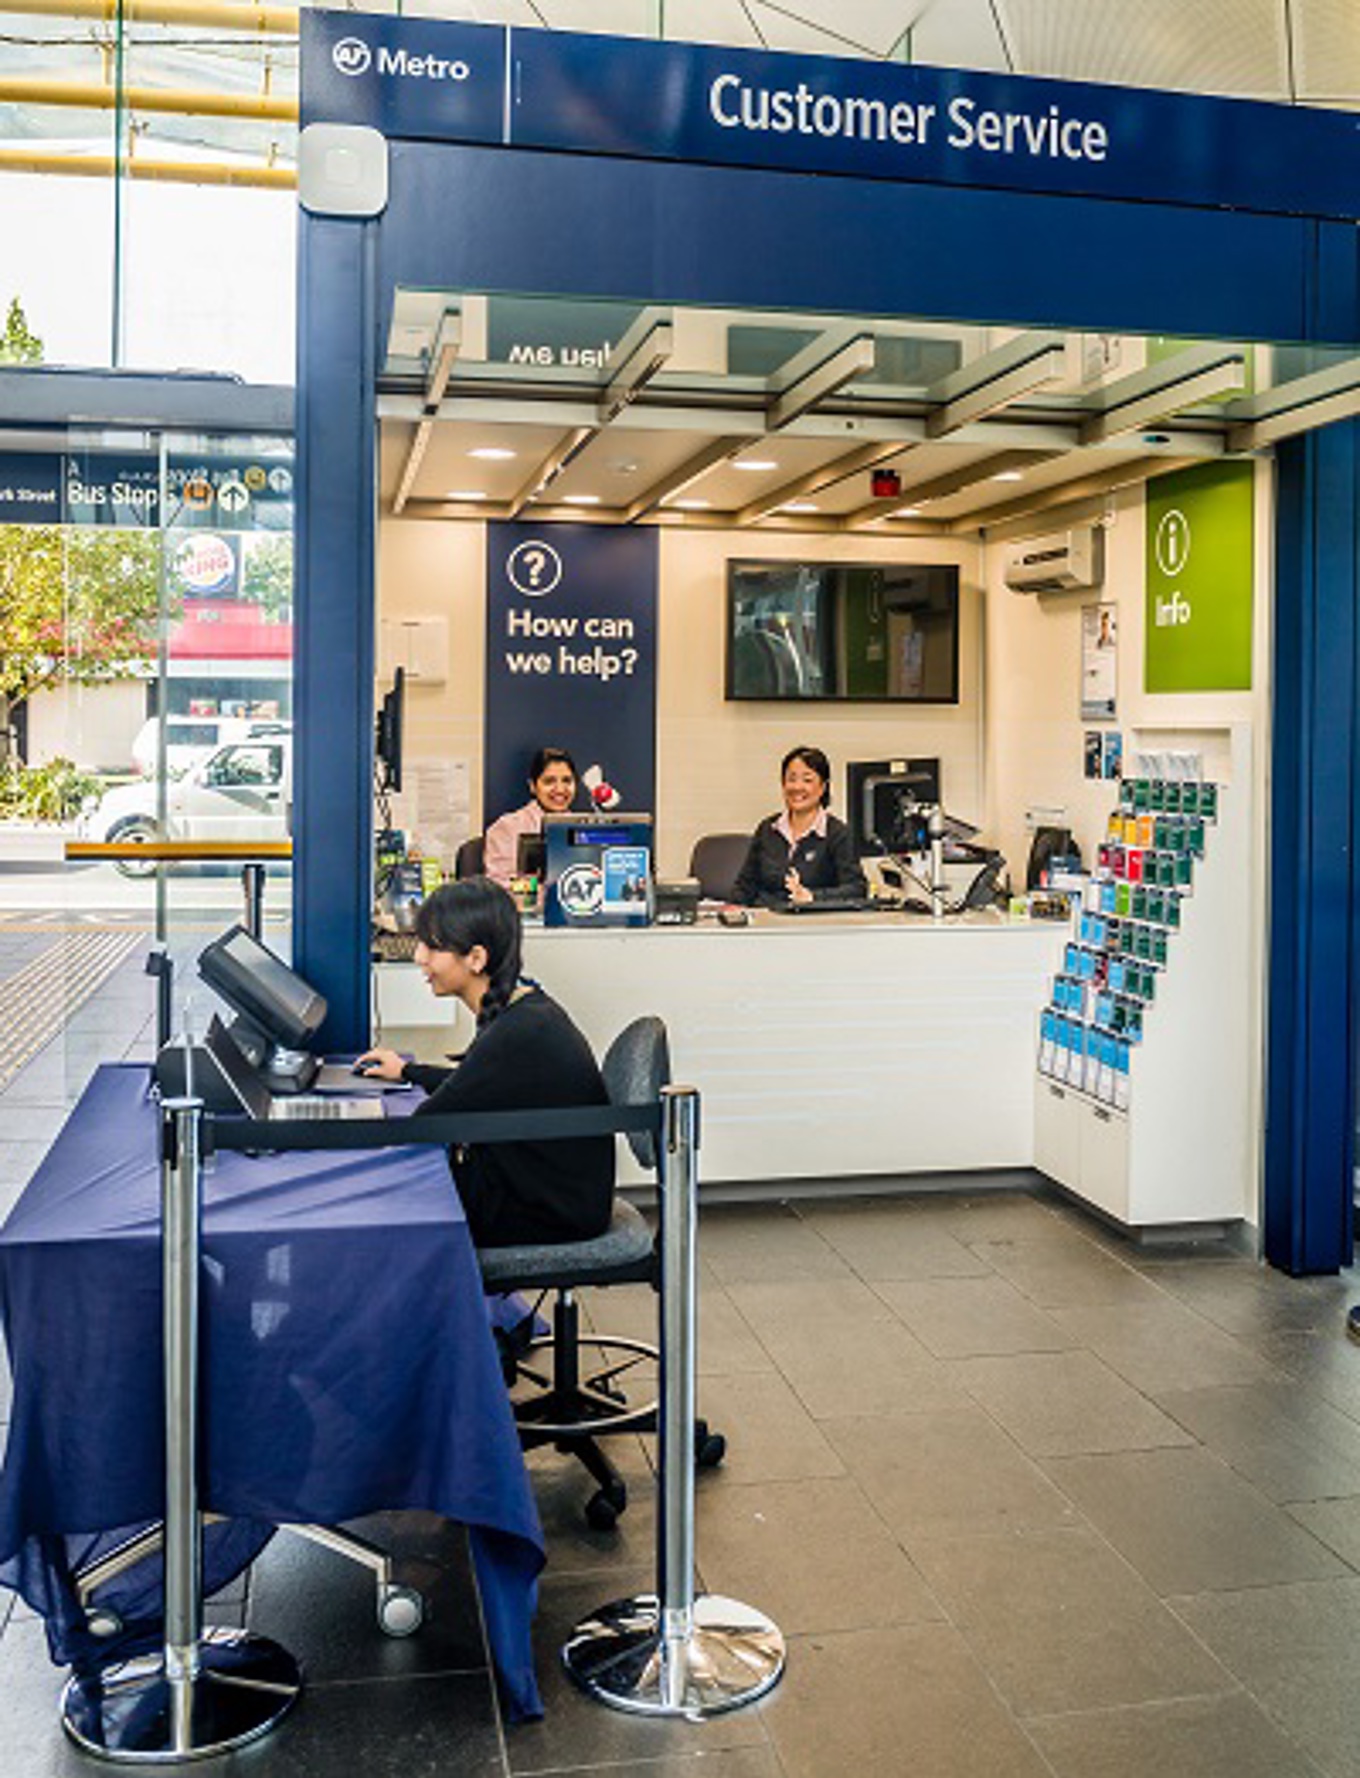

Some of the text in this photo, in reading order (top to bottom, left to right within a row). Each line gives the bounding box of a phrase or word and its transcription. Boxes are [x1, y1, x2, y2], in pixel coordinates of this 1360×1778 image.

[377, 46, 470, 80] Metro
[709, 74, 1109, 162] Customer Service
[67, 480, 106, 504] Bus
[508, 608, 634, 638] How can
[1156, 591, 1190, 627] Info
[506, 646, 638, 681] we help?
